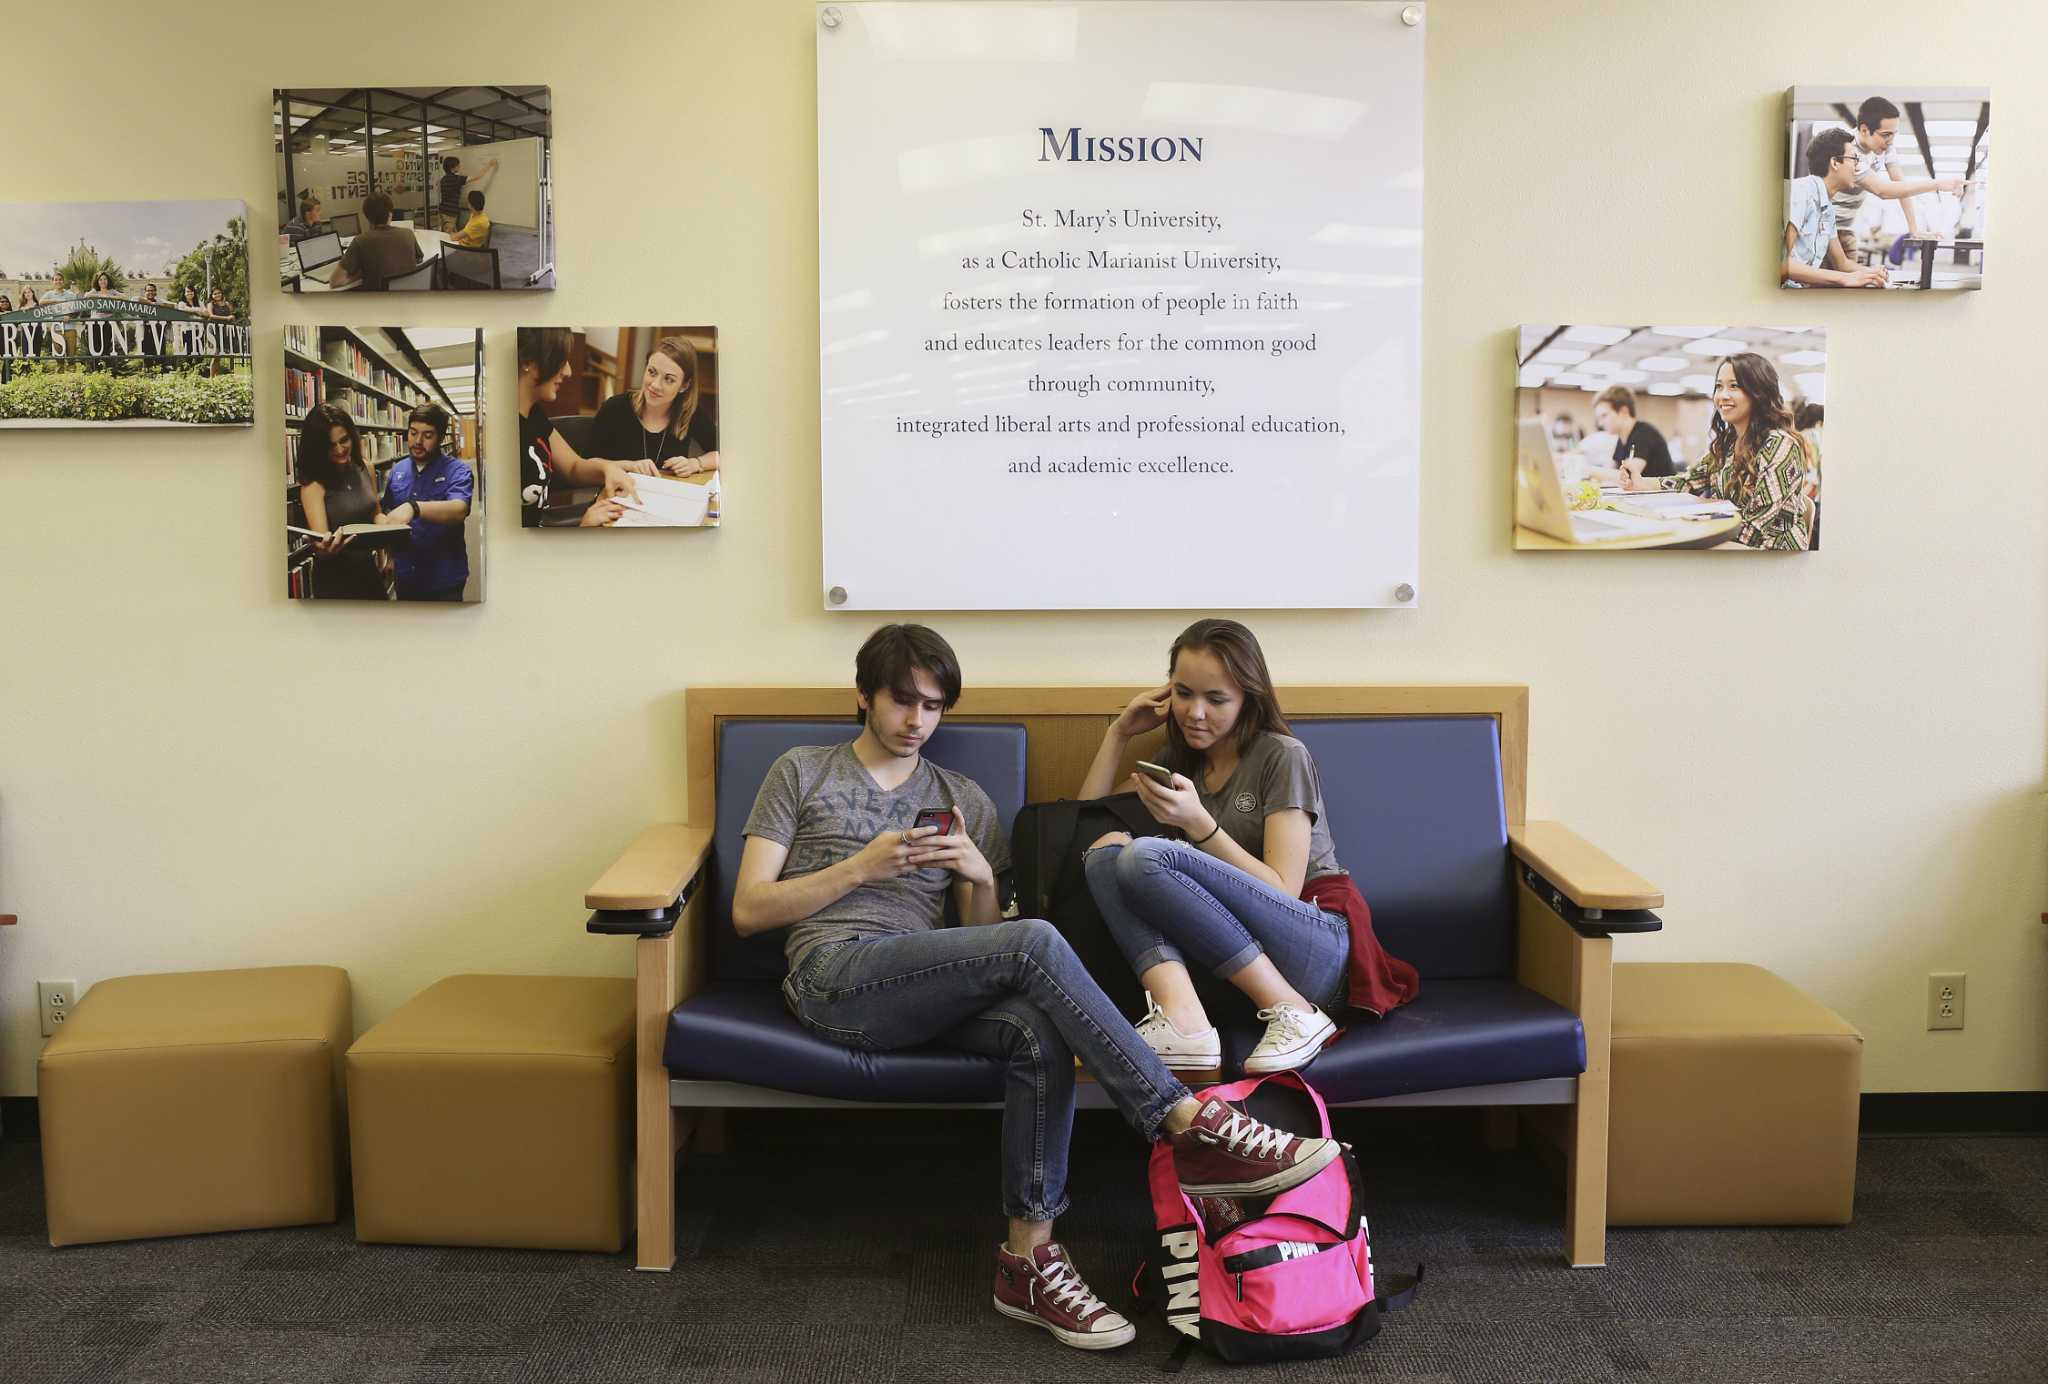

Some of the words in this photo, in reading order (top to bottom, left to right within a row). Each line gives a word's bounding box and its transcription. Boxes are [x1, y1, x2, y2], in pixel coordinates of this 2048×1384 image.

[1022, 208, 1047, 228] St.
[1054, 208, 1117, 234] Mary's
[1122, 208, 1222, 234] University,
[962, 256, 980, 269] as
[986, 256, 996, 269] a
[1001, 250, 1081, 269] Catholic
[1087, 250, 1177, 269] Marianist
[1184, 250, 1281, 275] University,
[33, 306, 54, 318] ONE
[97, 298, 127, 310] SANTA
[128, 301, 157, 316] MARIA
[943, 291, 1003, 310] fosters
[1009, 291, 1038, 310] the
[1044, 291, 1135, 310] formation
[1142, 291, 1164, 310] of
[1166, 291, 1226, 316] people
[1232, 293, 1250, 310] in
[1257, 291, 1298, 310] faith
[924, 332, 958, 351] and
[964, 332, 1043, 351] educates
[1048, 332, 1111, 351] leaders
[1117, 332, 1144, 351] for
[1150, 332, 1179, 351] the
[1185, 337, 1265, 351] common
[1270, 332, 1317, 357] good
[1028, 374, 1101, 398] through
[1107, 376, 1215, 398] community,
[896, 415, 990, 438] integrated
[995, 415, 1052, 433] liberal
[1058, 418, 1092, 433] arts
[1097, 414, 1131, 433] and
[1136, 414, 1246, 439] professional
[1251, 414, 1346, 437] education,
[1008, 456, 1042, 473] and
[1048, 456, 1132, 473] academic
[1138, 456, 1234, 473] excellence.
